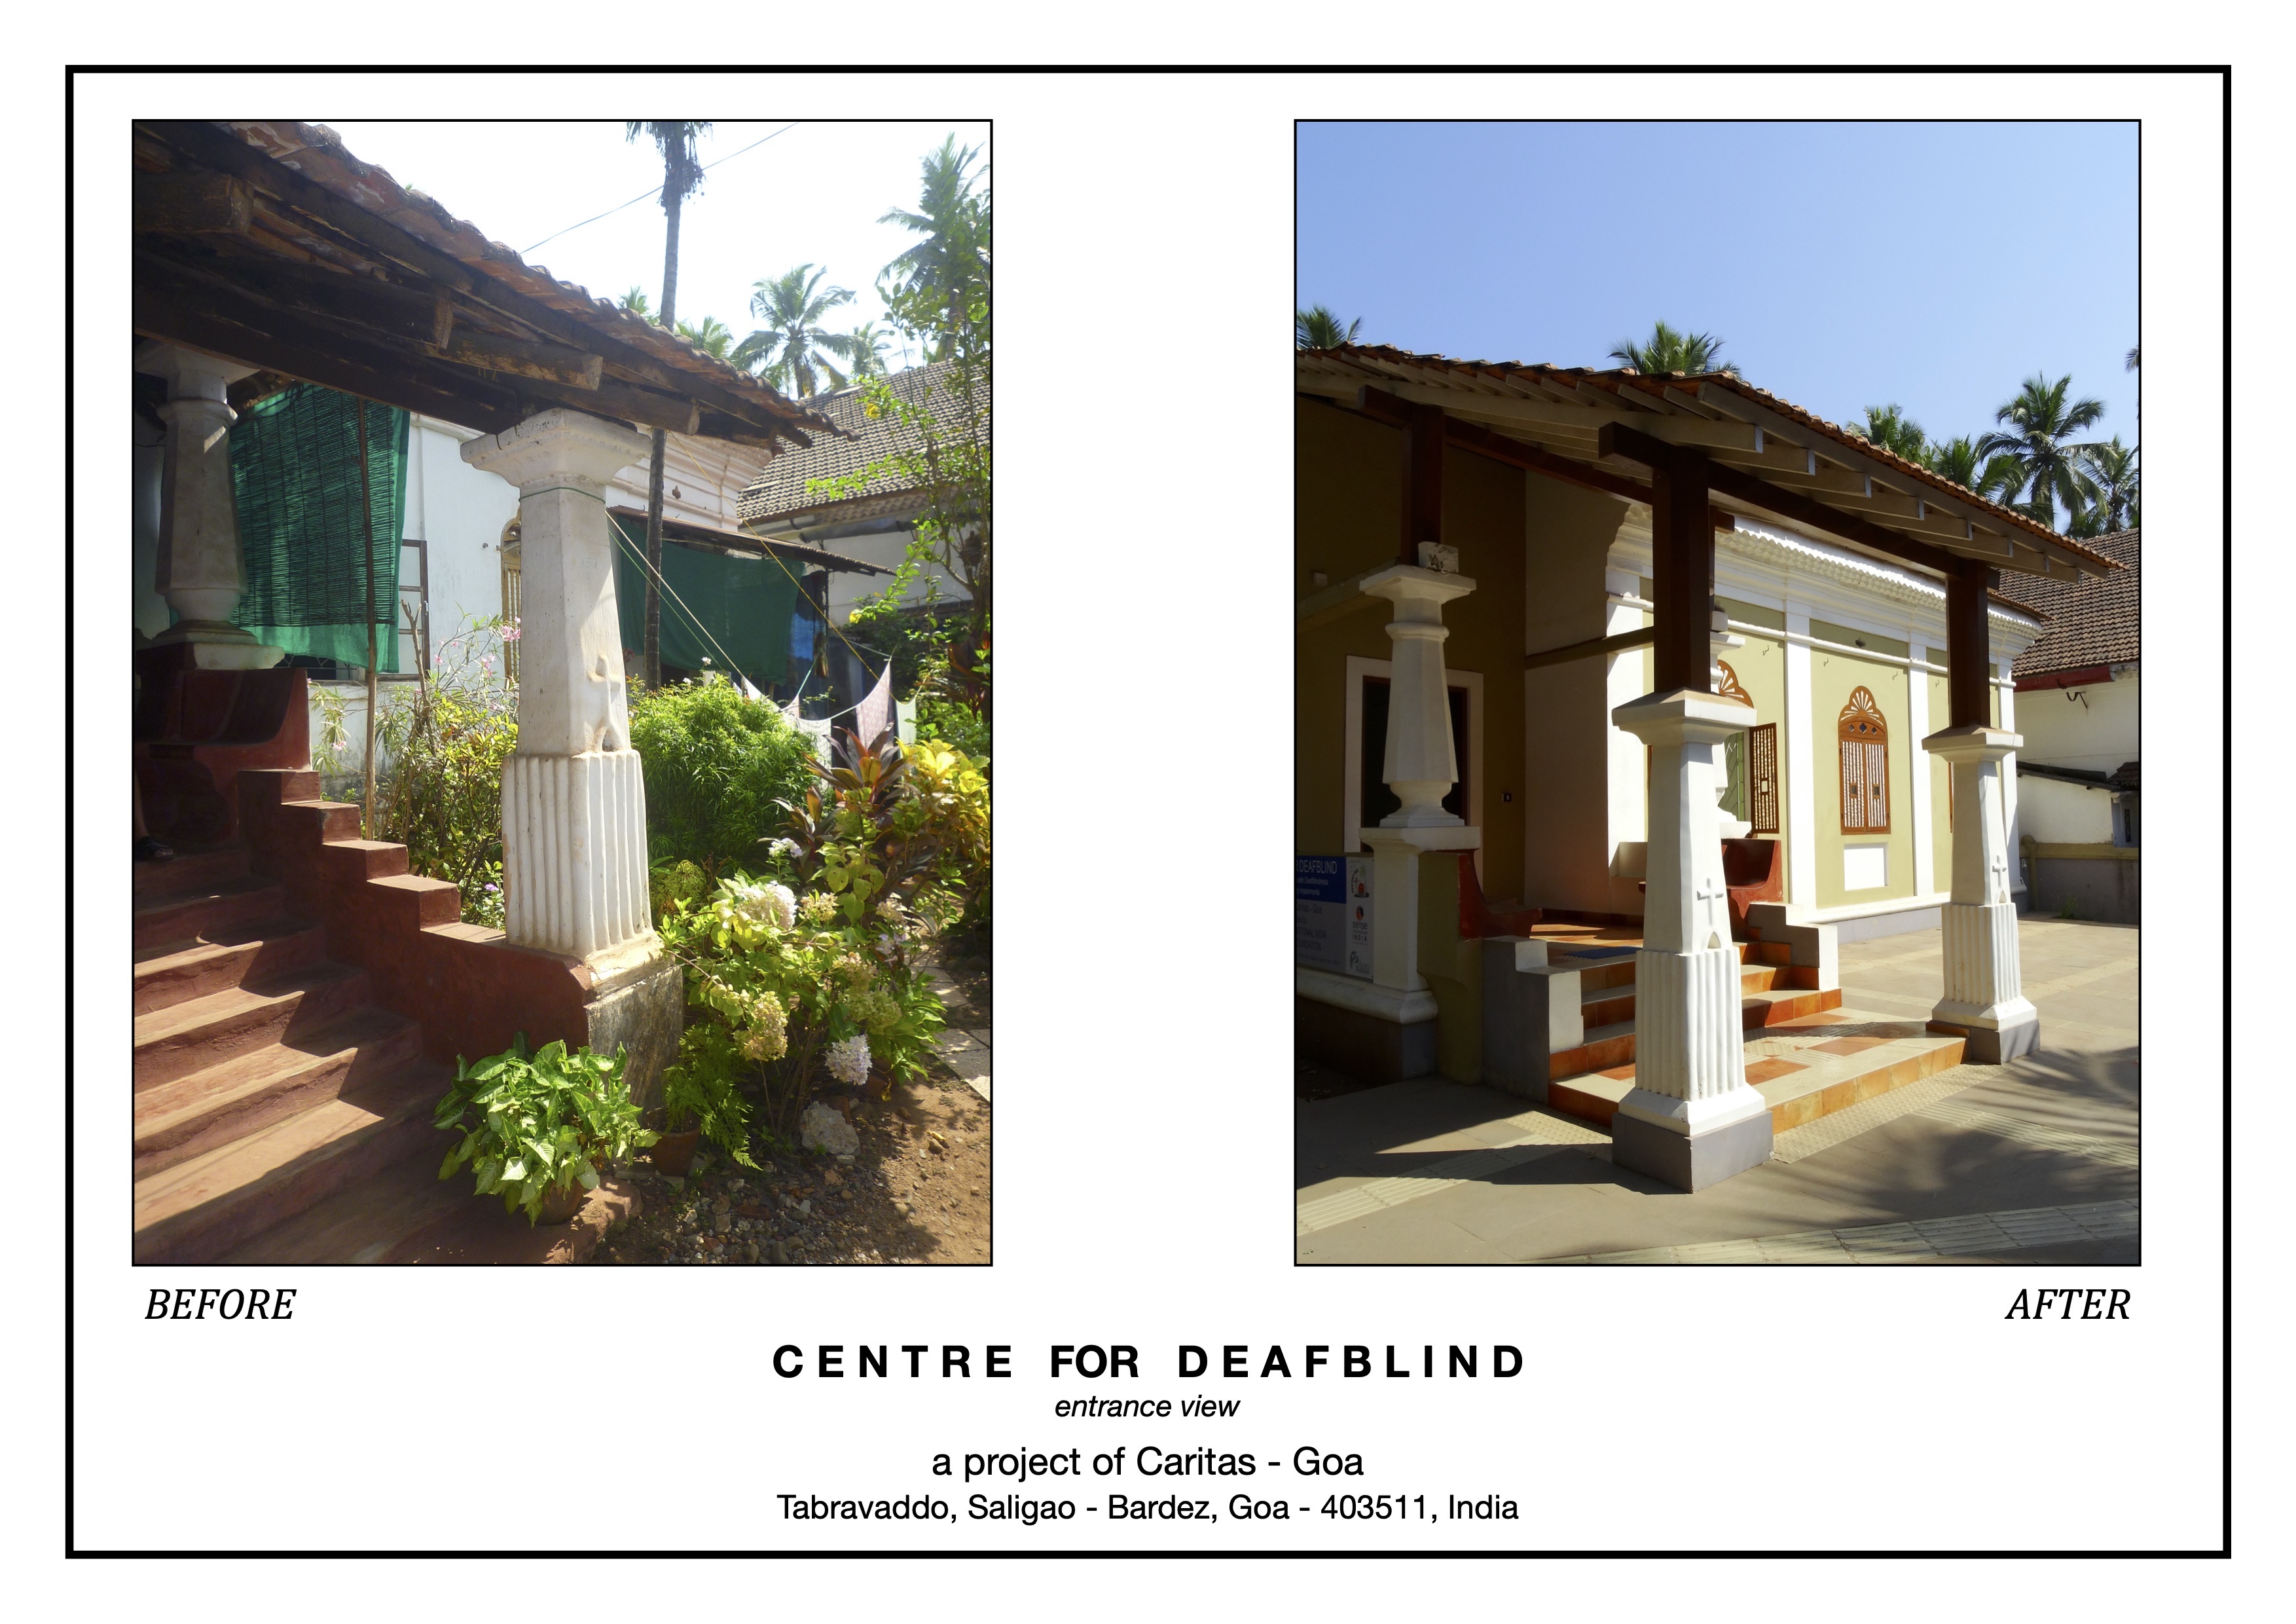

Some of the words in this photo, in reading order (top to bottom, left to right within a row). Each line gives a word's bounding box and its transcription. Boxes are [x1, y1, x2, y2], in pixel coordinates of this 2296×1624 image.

[1300, 860, 1338, 874] DEAFBLIND
[1353, 921, 1368, 930] sense
[1353, 933, 1368, 942] INDIA
